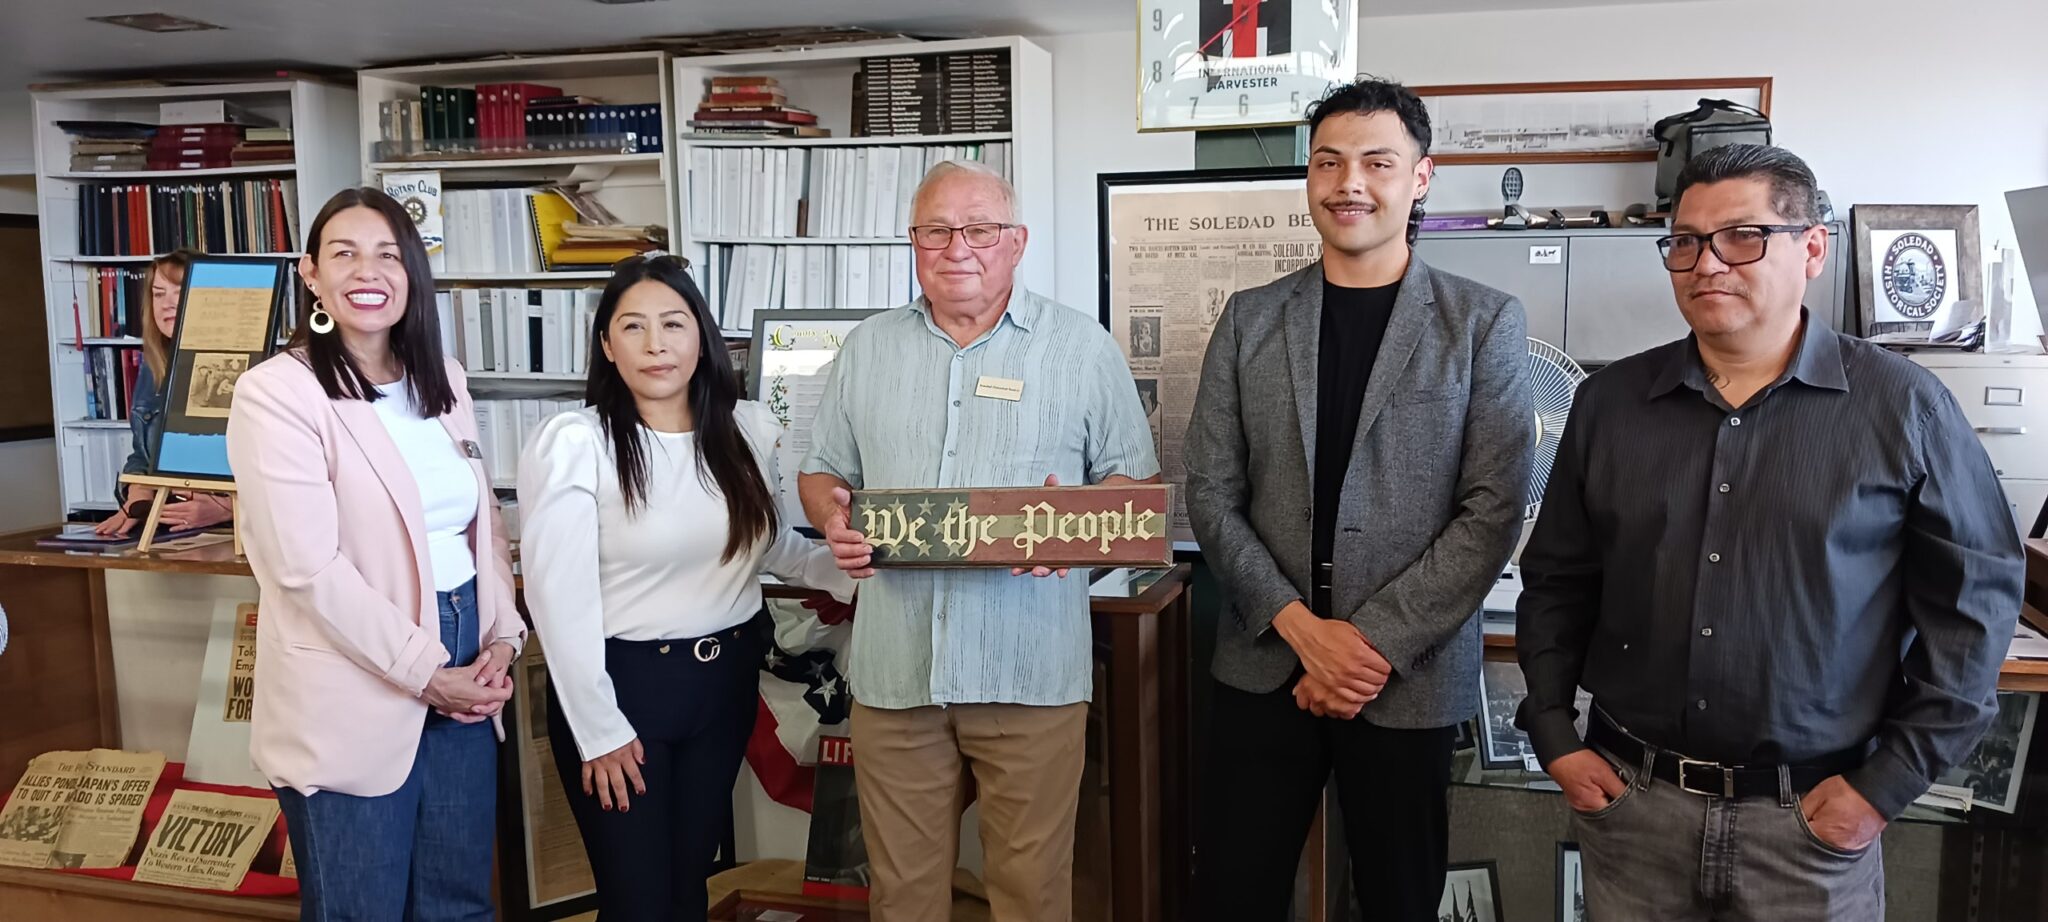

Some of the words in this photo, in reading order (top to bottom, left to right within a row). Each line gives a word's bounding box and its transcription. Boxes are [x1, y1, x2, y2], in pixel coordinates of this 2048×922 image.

[1152, 9, 1163, 31] 9
[1152, 61, 1162, 83] 8
[1198, 63, 1291, 79] INTERNATIONAL
[1189, 96, 1200, 120] 7
[1238, 93, 1249, 117] 6
[1290, 91, 1300, 114] 5
[1144, 217, 1179, 231] THE
[1189, 215, 1275, 231] SOLEDAD
[1288, 213, 1317, 228] BE
[1273, 243, 1304, 258] SOLEDAD
[1306, 243, 1315, 257] IS
[1892, 236, 1934, 255] SOLEDAD
[1884, 265, 1925, 317] HISTORICAL
[1924, 264, 1945, 313] SOCIETY
[861, 504, 927, 548] We
[940, 504, 1000, 558] the
[1013, 499, 1157, 560] People
[233, 676, 254, 698] WO
[57, 762, 74, 772] THE
[86, 760, 136, 775] STANDARD
[22, 775, 52, 788] ALLIES
[76, 775, 121, 793] JAPAN'S
[121, 779, 151, 793] OFFER
[16, 787, 28, 800] TO
[30, 789, 50, 803] QUIT
[52, 790, 62, 803] IF
[95, 792, 104, 805] IS
[108, 793, 145, 807] SPARED
[156, 813, 255, 859] VICTORY
[143, 857, 154, 867] To
[155, 858, 183, 872] Western
[206, 866, 231, 878] Russia
[146, 847, 169, 859] Nazis
[170, 851, 199, 864] Reveal
[196, 855, 236, 869] Surrender
